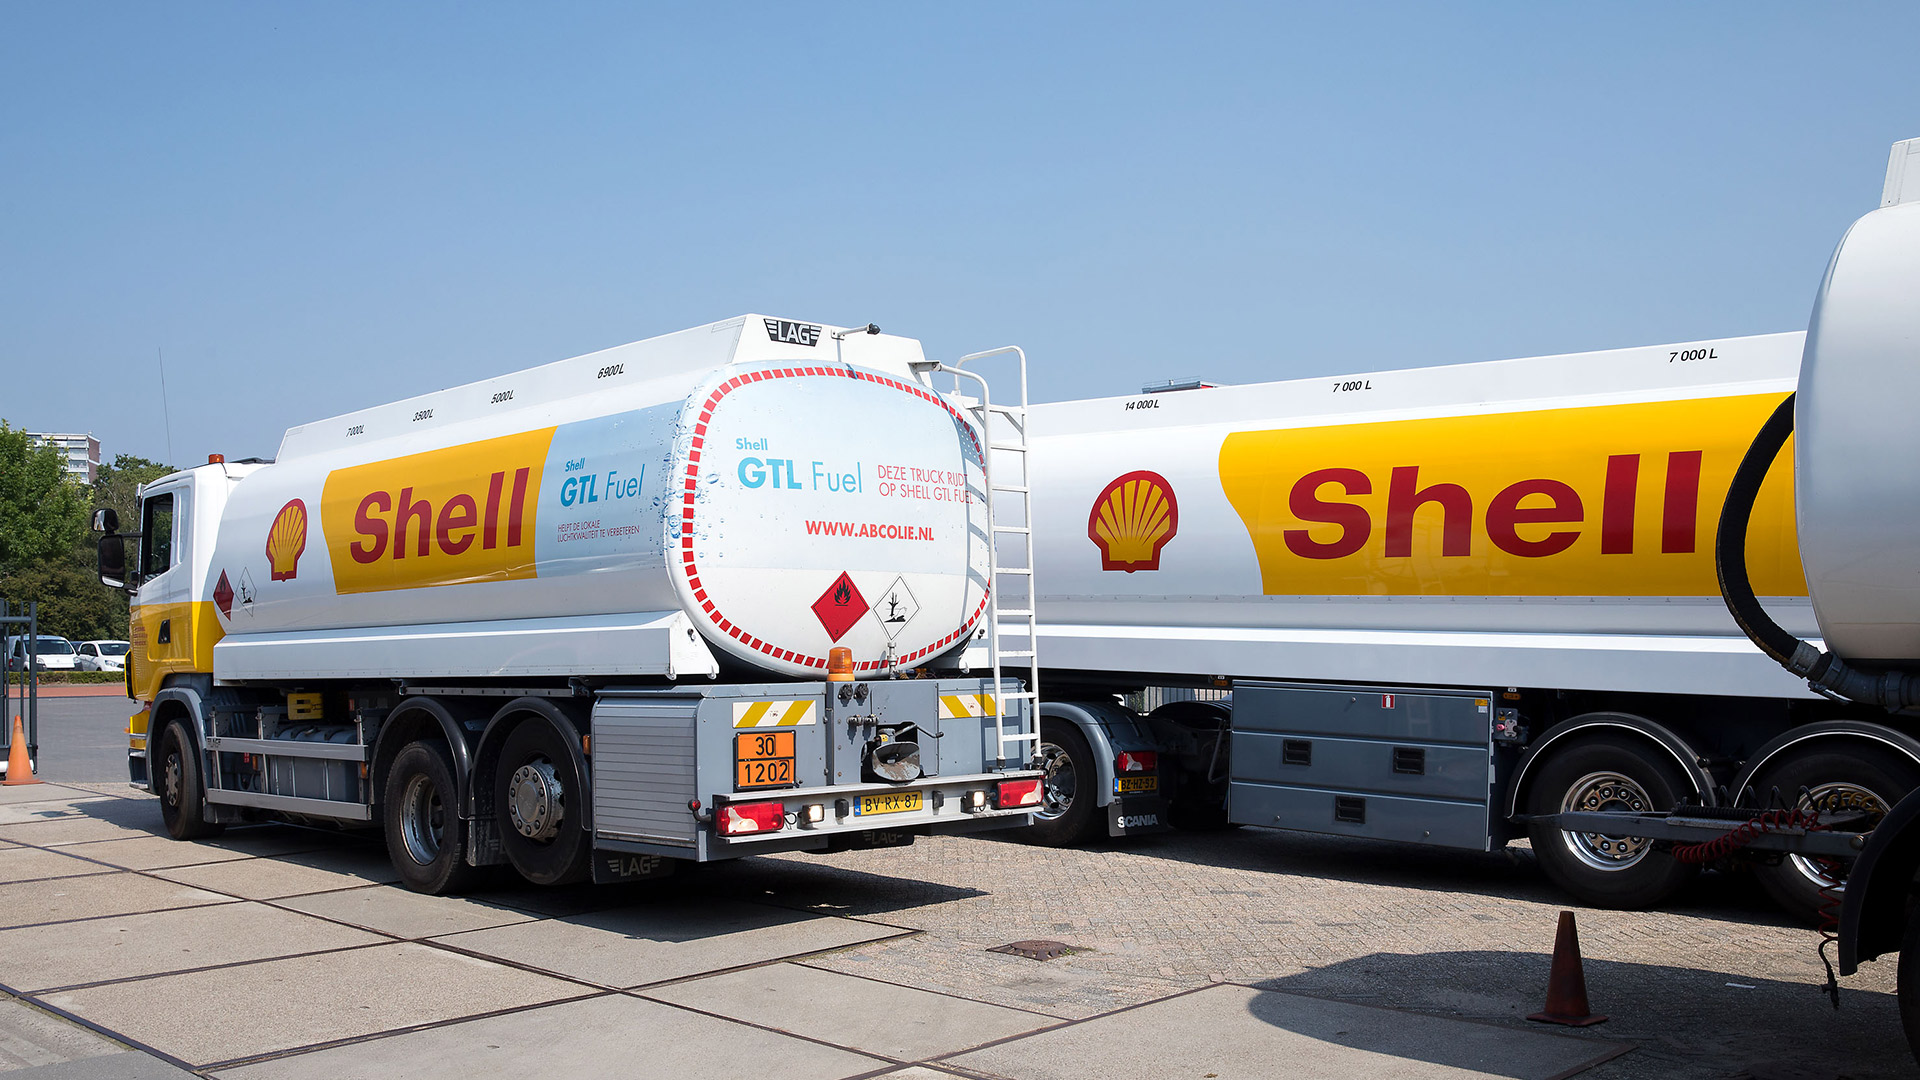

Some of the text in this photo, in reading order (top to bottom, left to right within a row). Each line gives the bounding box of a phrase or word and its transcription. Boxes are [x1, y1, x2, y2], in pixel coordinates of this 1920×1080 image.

[778, 321, 811, 345] LAG
[1669, 347, 1718, 363] 7 000 L
[597, 362, 624, 379] 6900L
[1333, 382, 1341, 393] 7
[1342, 380, 1363, 392] 000
[490, 389, 515, 405] 5000L
[1125, 401, 1136, 411] 14
[412, 408, 434, 423] 3500L
[345, 424, 365, 438] 7000L
[735, 437, 768, 451] Shell
[564, 457, 586, 473] Shell
[737, 456, 863, 494] GTL Fuel
[877, 464, 907, 481] DEZE
[909, 467, 945, 485] TRUCK
[560, 463, 646, 508] GTL Fuel
[878, 481, 974, 505] OP SHELL GTL FUEL
[1283, 450, 1703, 560] Shell
[350, 467, 530, 565] Shell
[573, 521, 581, 531] DE
[581, 520, 600, 530] LOKALE
[599, 528, 606, 538] TE
[606, 525, 640, 537] VERBETEREN
[805, 520, 935, 541] WWW.ABCOLIE.NL
[755, 736, 776, 757] 30
[744, 761, 788, 783] 1202
[864, 793, 919, 813] BV-RX-87
[1117, 814, 1158, 828] SCANIA
[620, 856, 651, 877] LAG
